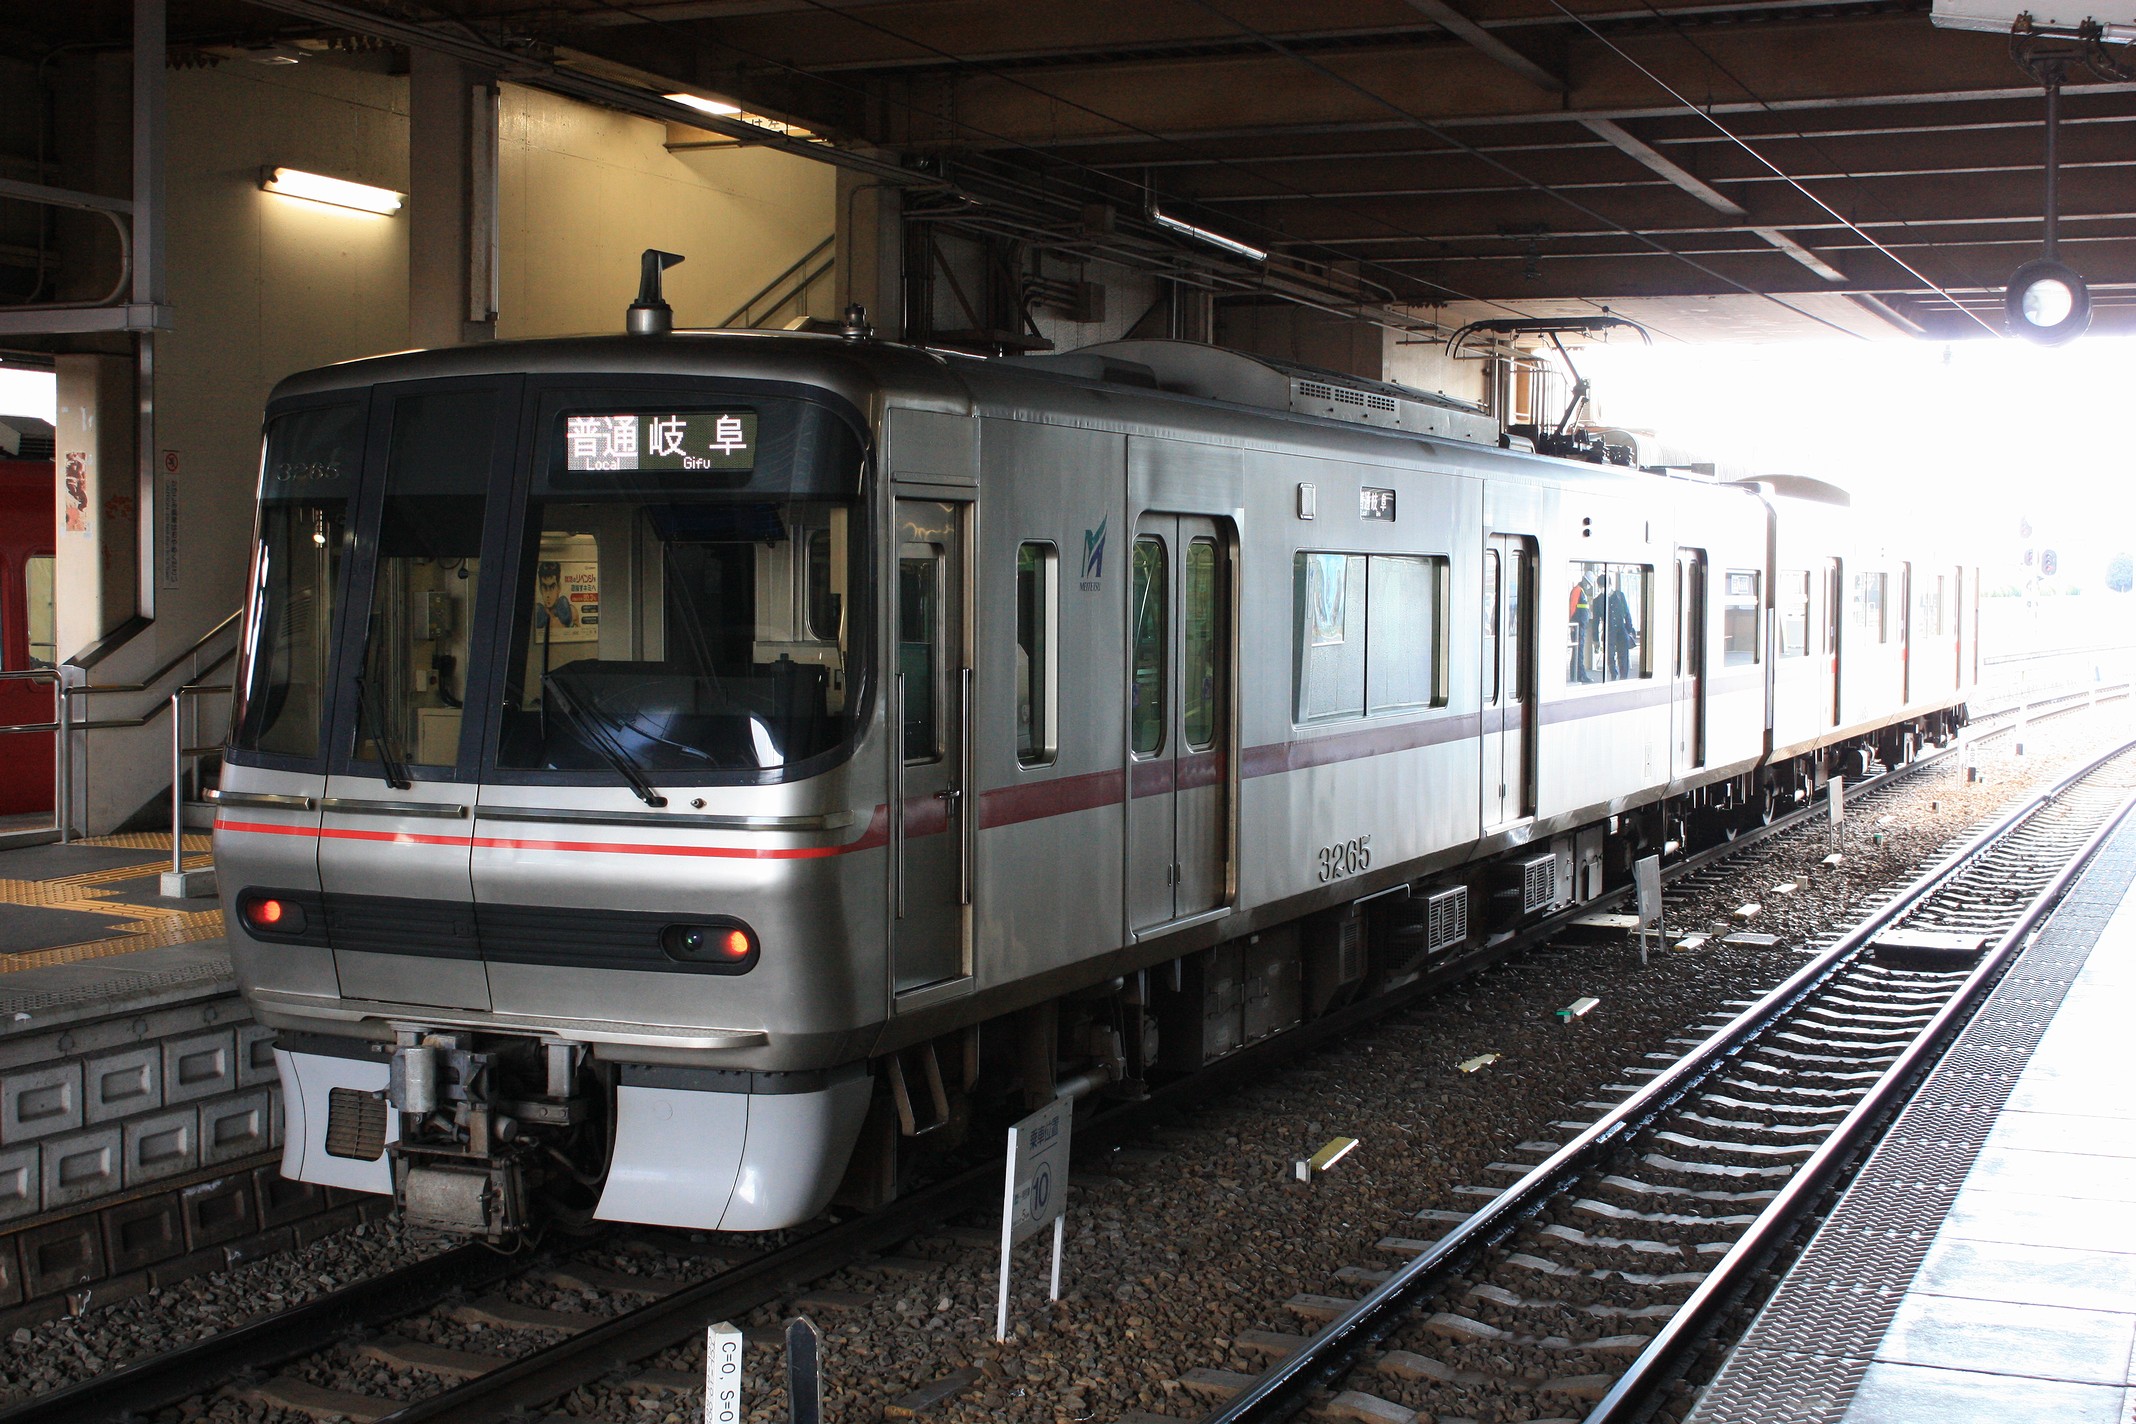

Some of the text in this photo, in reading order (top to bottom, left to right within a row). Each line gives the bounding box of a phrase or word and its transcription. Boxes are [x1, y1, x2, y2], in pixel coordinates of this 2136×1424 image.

[568, 414, 747, 457] 普通 岐阜
[276, 462, 340, 481] 3265
[586, 456, 711, 470] Local Gifu
[1318, 834, 1372, 883] 3265
[1029, 1115, 1060, 1150] 乗車位置
[1033, 1172, 1049, 1211] 10
